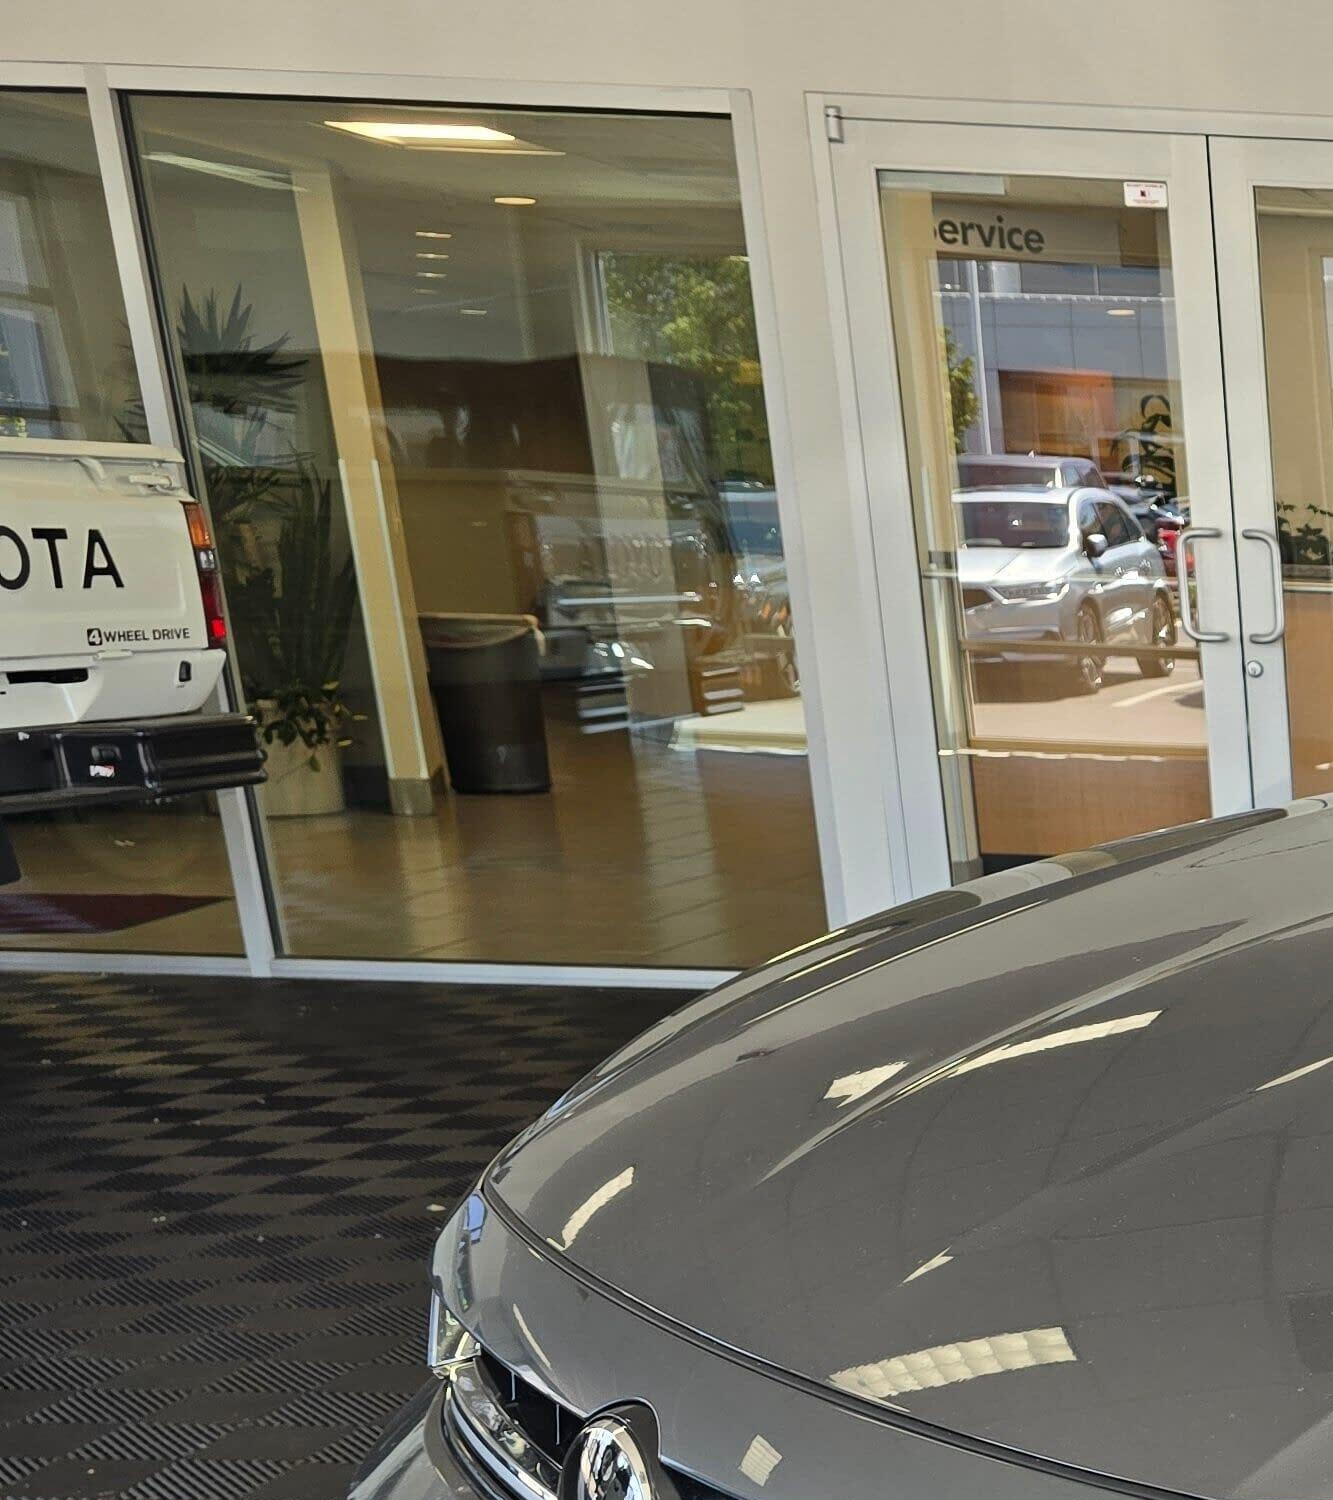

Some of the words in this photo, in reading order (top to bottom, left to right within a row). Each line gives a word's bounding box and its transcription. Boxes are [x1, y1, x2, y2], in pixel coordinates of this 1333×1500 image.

[933, 215, 1045, 254] ervice
[103, 629, 149, 643] WHEEL
[152, 627, 190, 641] DRIVE
